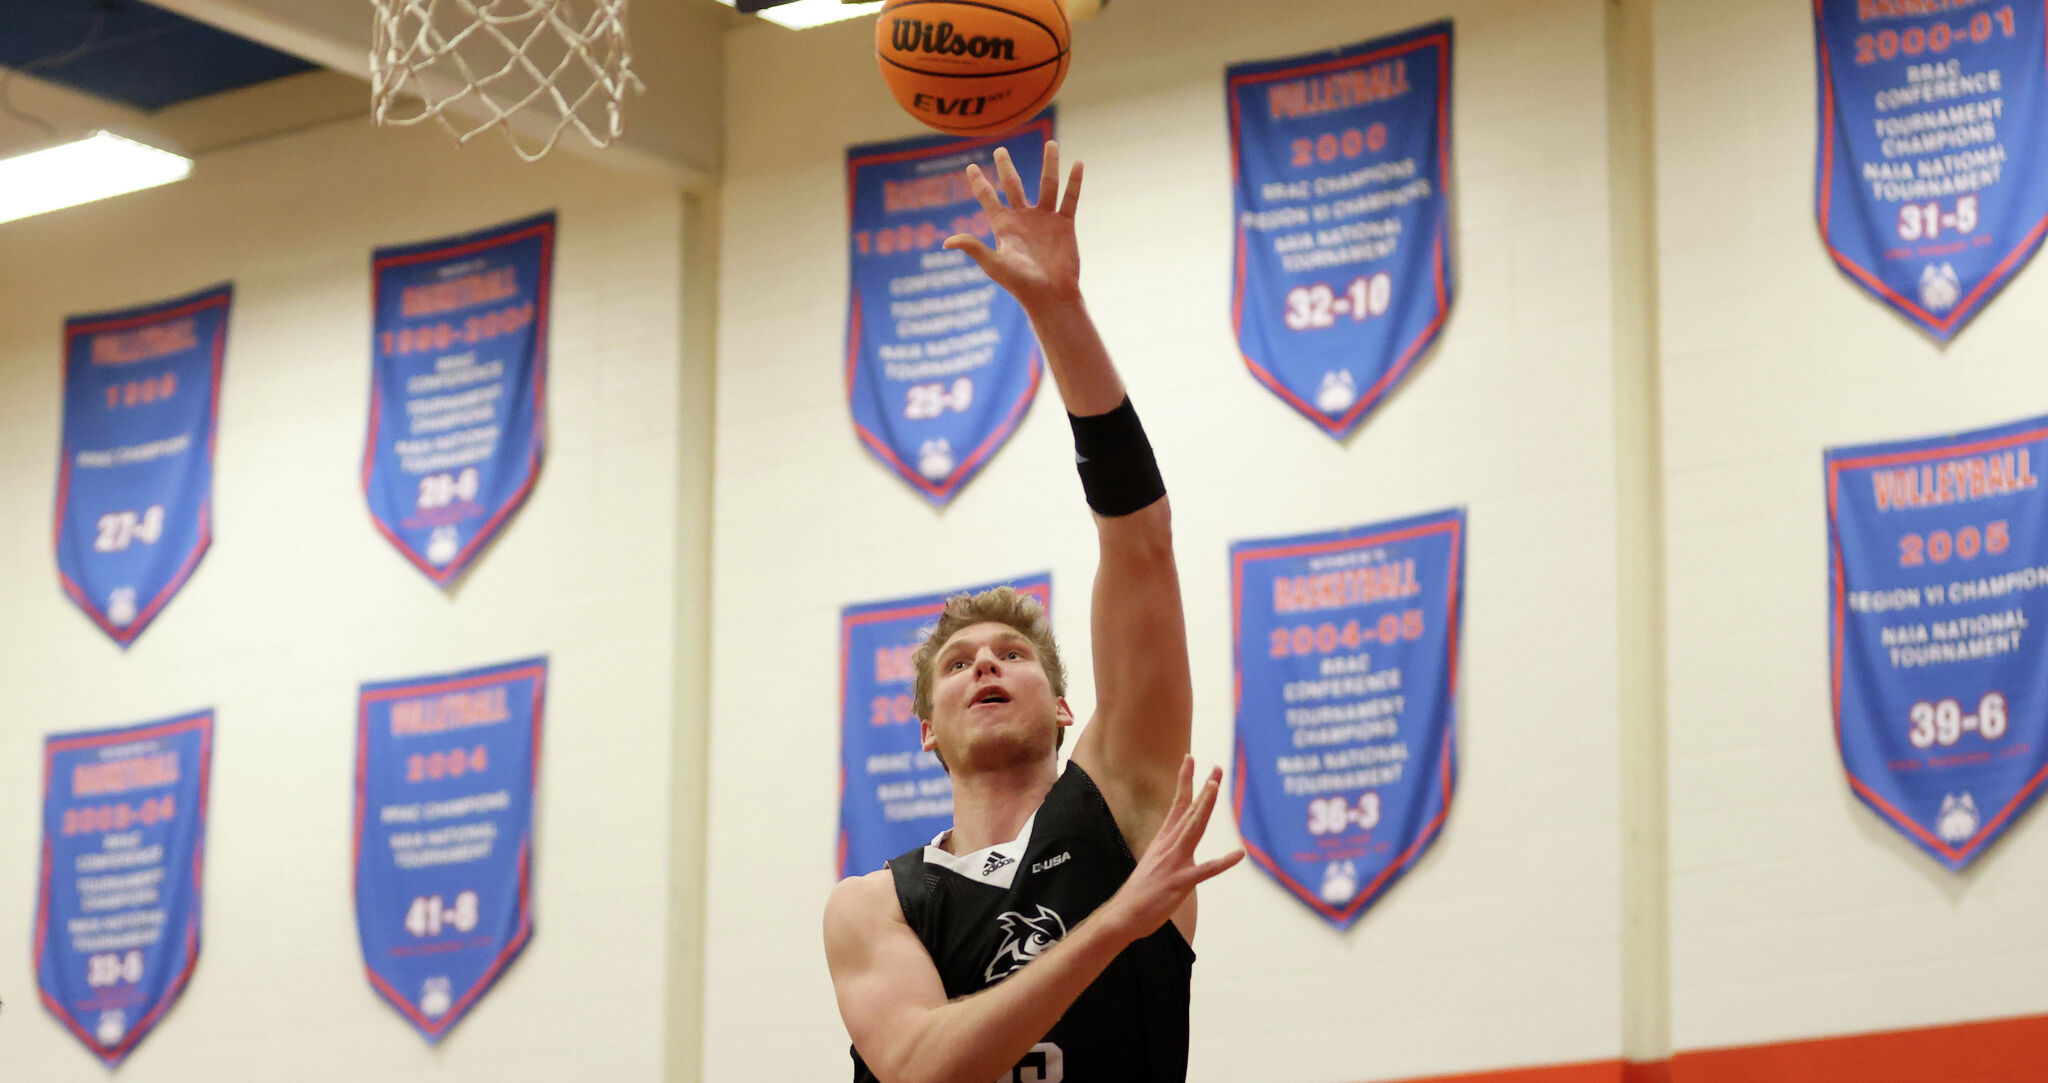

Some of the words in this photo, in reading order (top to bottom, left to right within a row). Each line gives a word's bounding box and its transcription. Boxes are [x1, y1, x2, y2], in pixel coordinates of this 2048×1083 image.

[892, 18, 1016, 61] Wilson
[1855, 6, 2015, 65] 2000-01
[1874, 69, 2002, 112] CONFERENCE
[1874, 97, 2003, 138] TOURNAMENT
[1881, 120, 1996, 159] CHAMPIONS
[1291, 122, 1387, 168] 2000
[1872, 163, 2002, 201] TOURNAMENT
[1898, 193, 1979, 241] 31-5
[1285, 271, 1391, 331] 32-10
[1873, 446, 2038, 512] VOLLEYBALL
[1899, 520, 2010, 568] 2005
[1274, 557, 1421, 613] BASKETBALL
[1269, 610, 1425, 659] 2004-05
[1881, 622, 1929, 646] NAIA
[1931, 607, 2029, 640] NATIONAL
[1889, 628, 2023, 668] TOURNAMENT
[1909, 691, 2008, 748] 39-6
[982, 858, 1016, 877] adidas
